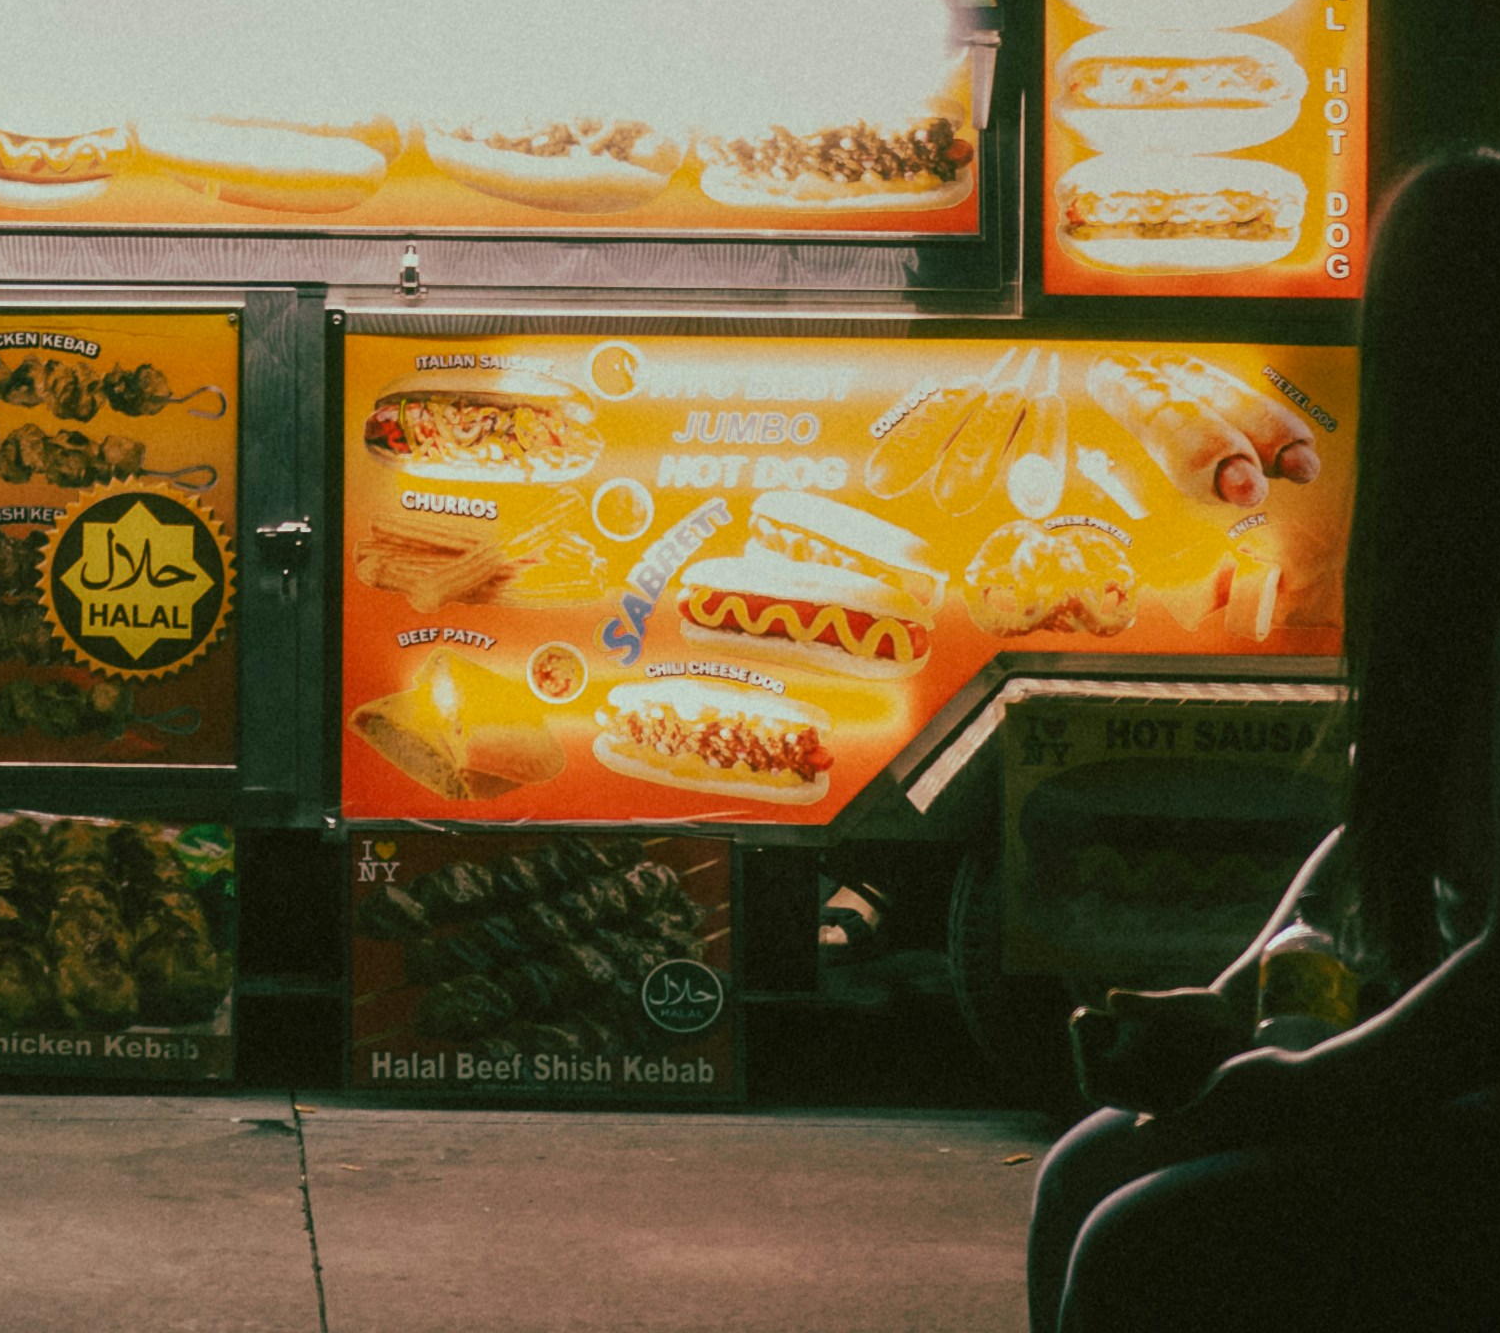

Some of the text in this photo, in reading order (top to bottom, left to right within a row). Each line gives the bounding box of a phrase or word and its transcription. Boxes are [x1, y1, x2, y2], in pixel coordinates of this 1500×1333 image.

[1323, 68, 1349, 155] HOT
[1326, 191, 1350, 279] DOG
[42, 333, 99, 357] KEBAB
[415, 355, 475, 370] ITALIAN
[1261, 365, 1338, 432] PRETZEL DOG
[671, 411, 819, 445] JUMBO
[657, 455, 849, 489] HOT DOG
[401, 490, 498, 520] CHURROS
[80, 529, 198, 592] حلال
[593, 497, 734, 667] SABRETT
[88, 602, 190, 630] HALAL
[397, 626, 496, 651] BEEF PATTY
[644, 659, 787, 695] CHILI CHEESE DOG
[1104, 720, 1181, 751] HOT
[358, 861, 400, 883] NY
[648, 973, 718, 1005] حلال
[103, 1032, 200, 1061] Kebab
[371, 1051, 715, 1084] Halal Beef Shish Kebab
